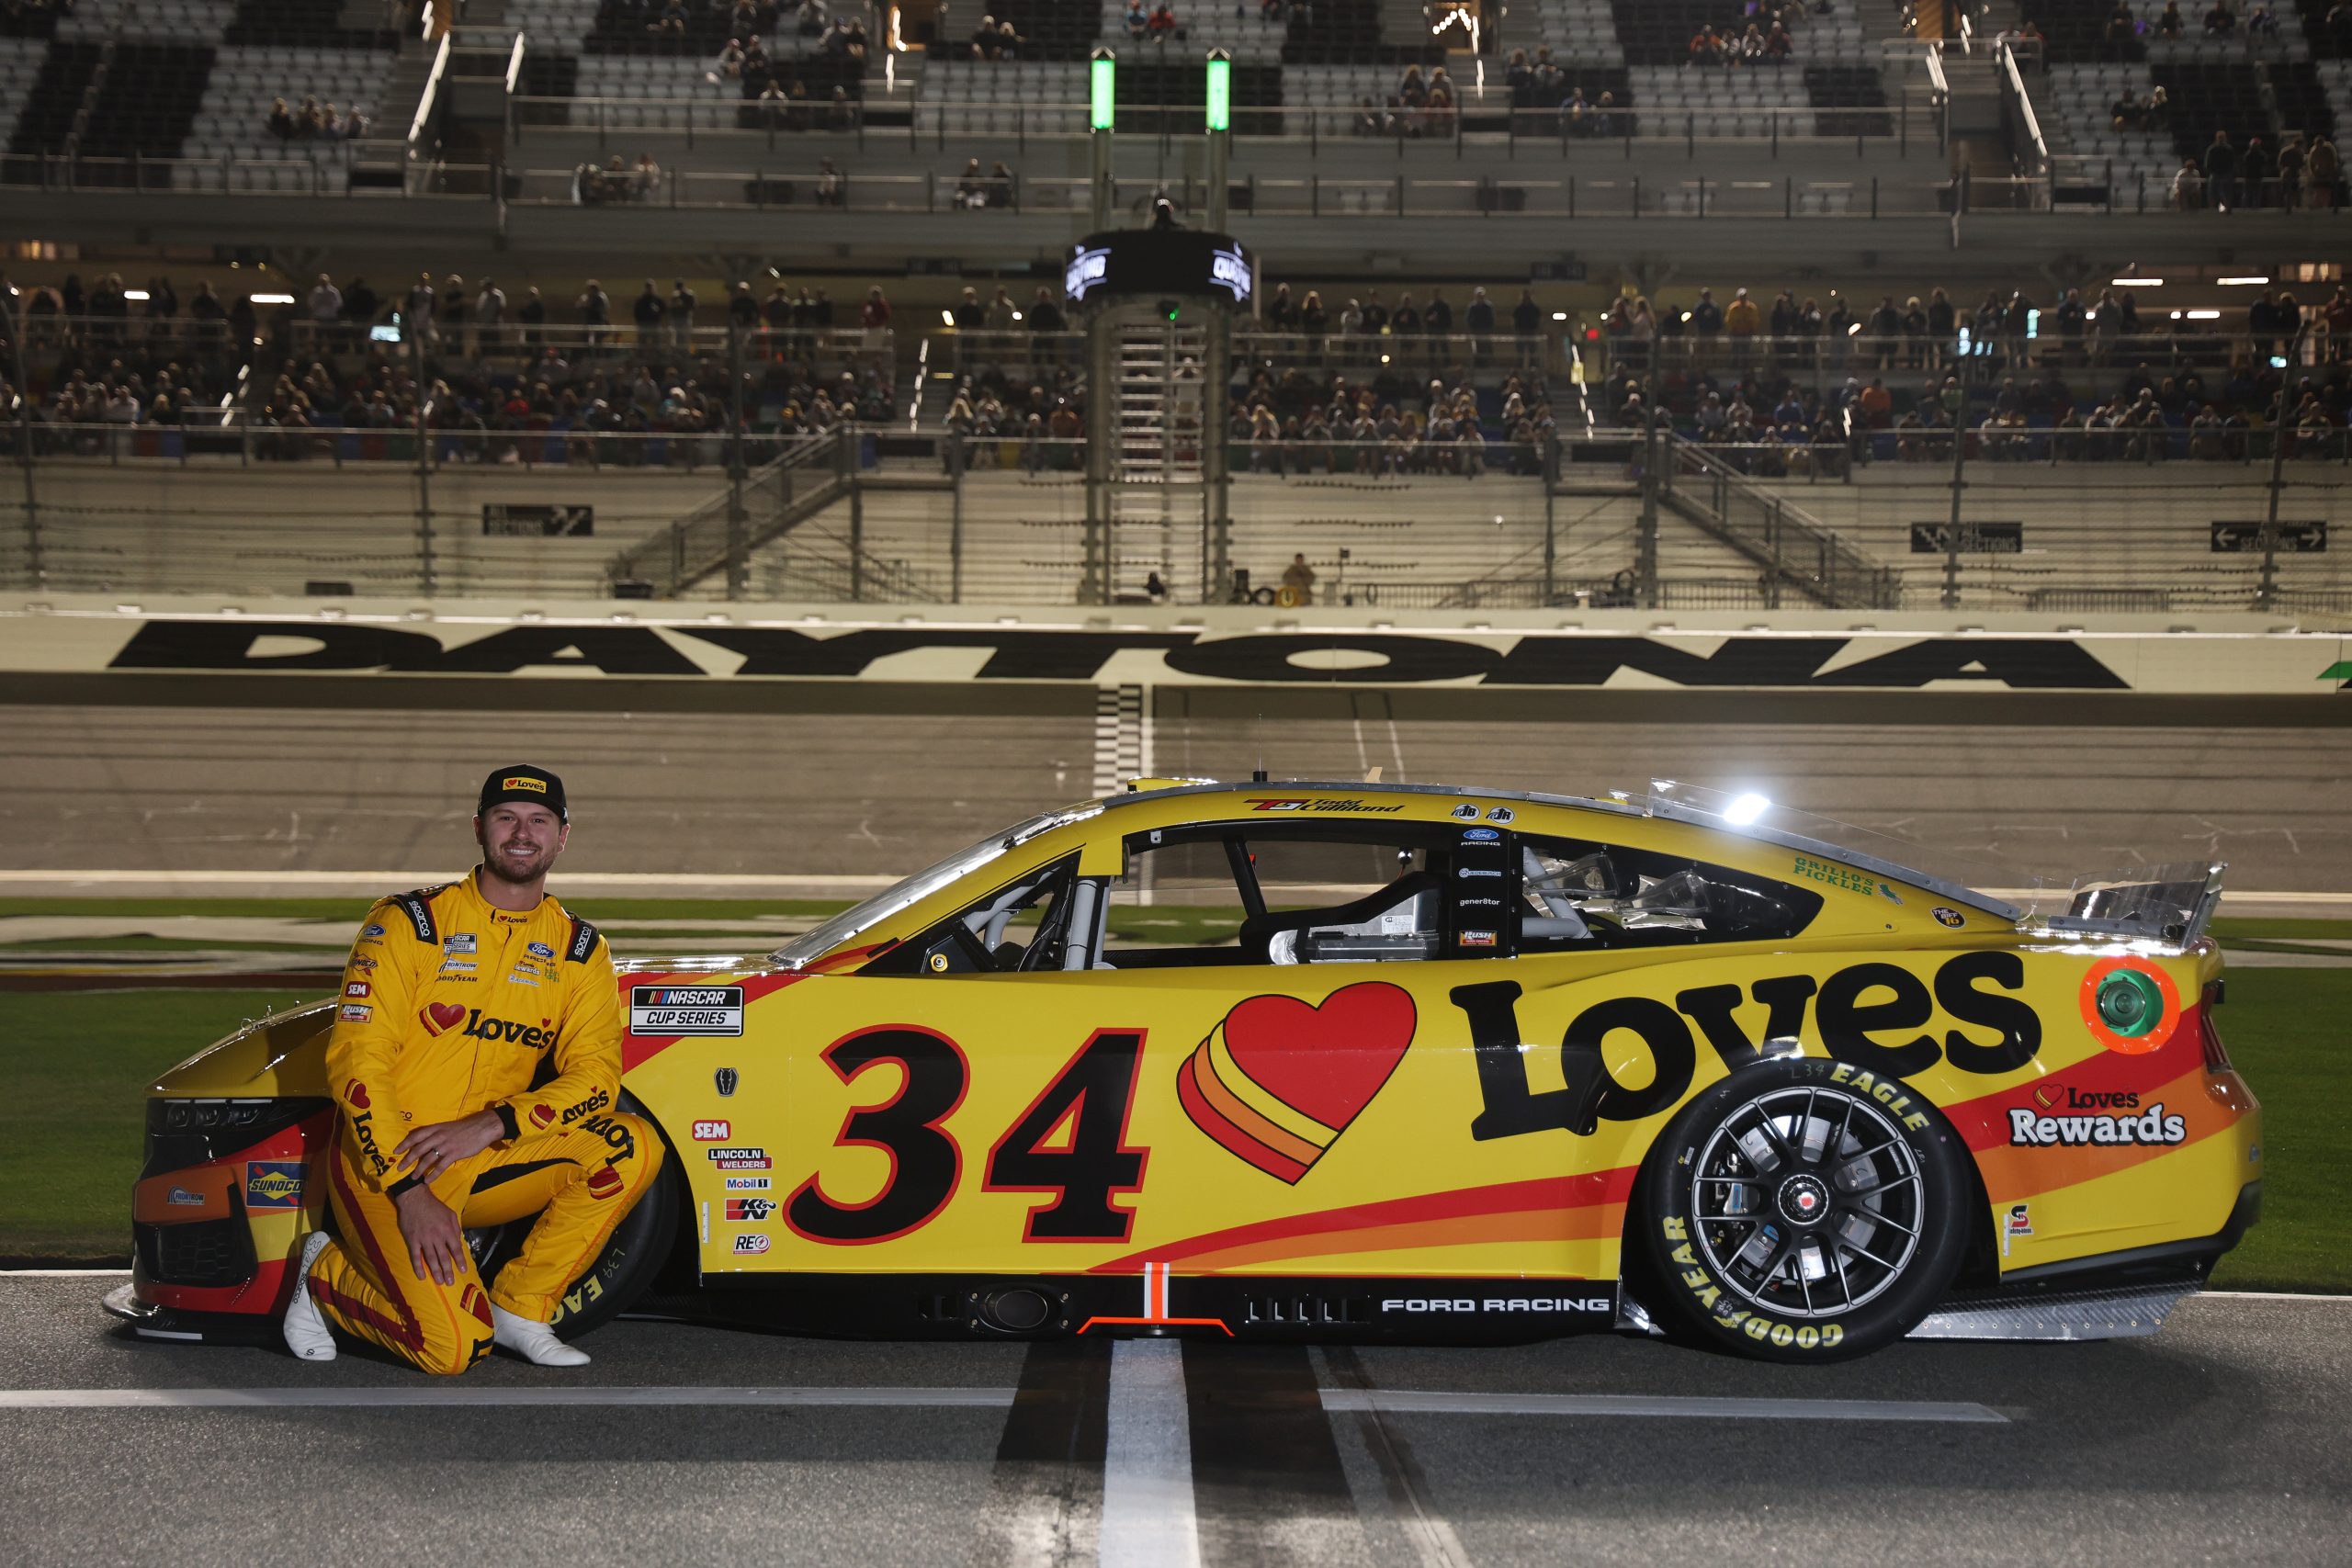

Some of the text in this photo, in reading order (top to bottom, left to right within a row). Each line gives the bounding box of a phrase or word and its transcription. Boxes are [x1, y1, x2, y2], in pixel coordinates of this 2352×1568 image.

[107, 620, 2133, 690] DAYTONA
[1299, 804, 1407, 812] Gilliland
[1793, 864, 1873, 897] PICKLES
[1459, 897, 1501, 907] gener8tor
[1945, 917, 1960, 926] 16
[347, 984, 367, 996] SEM
[667, 990, 727, 1005] NASCAR
[647, 1011, 728, 1024] CUP SERIES
[1830, 1063, 1930, 1133] EAGLE
[695, 1122, 729, 1138] SEM
[2007, 1102, 2187, 1146] Rewards
[782, 1022, 1151, 1247] 34
[710, 1149, 761, 1159] LINCOLN
[722, 1160, 766, 1168] WELDERS
[250, 1179, 302, 1192] SUNOCO
[727, 1179, 756, 1189] Mobil
[1662, 1216, 1844, 1348] GOODYEAR
[1382, 1298, 1610, 1312] FORD RACING
